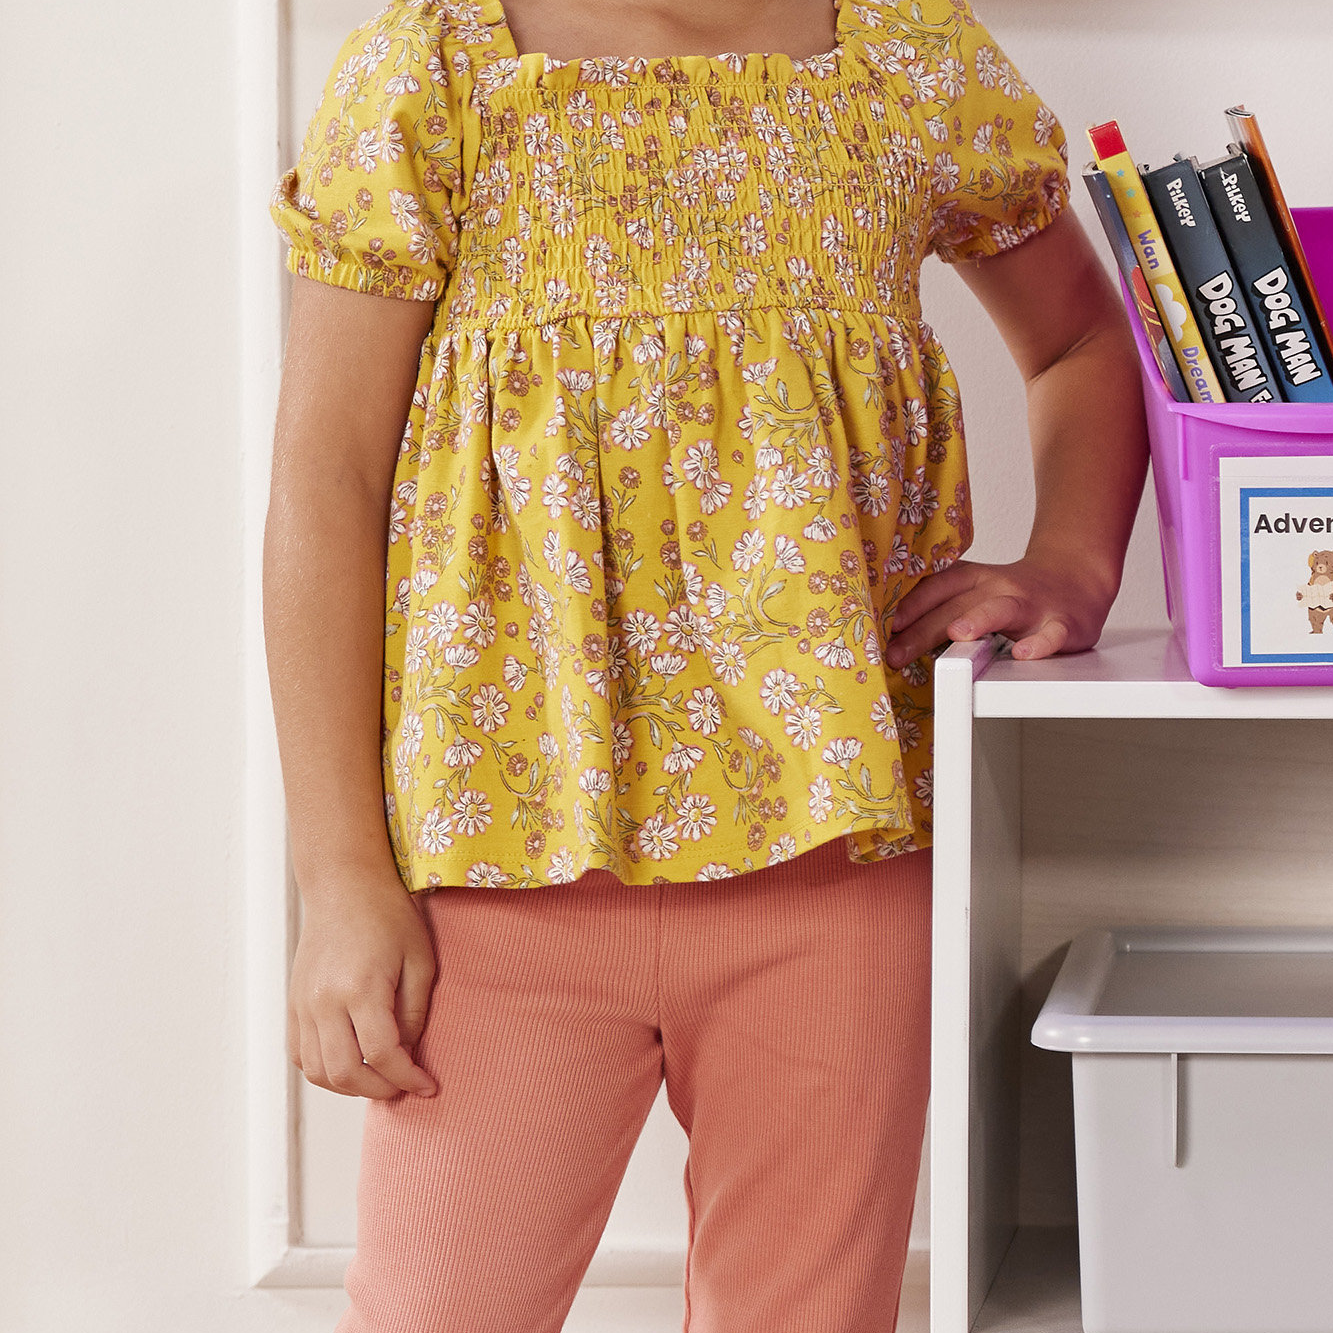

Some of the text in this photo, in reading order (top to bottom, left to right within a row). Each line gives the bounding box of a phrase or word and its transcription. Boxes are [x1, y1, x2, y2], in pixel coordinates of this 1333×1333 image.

[1137, 229, 1160, 270] Wan
[1197, 270, 1246, 335] DOG
[1253, 265, 1323, 387] DOG MAN
[1220, 335, 1268, 392] MAN
